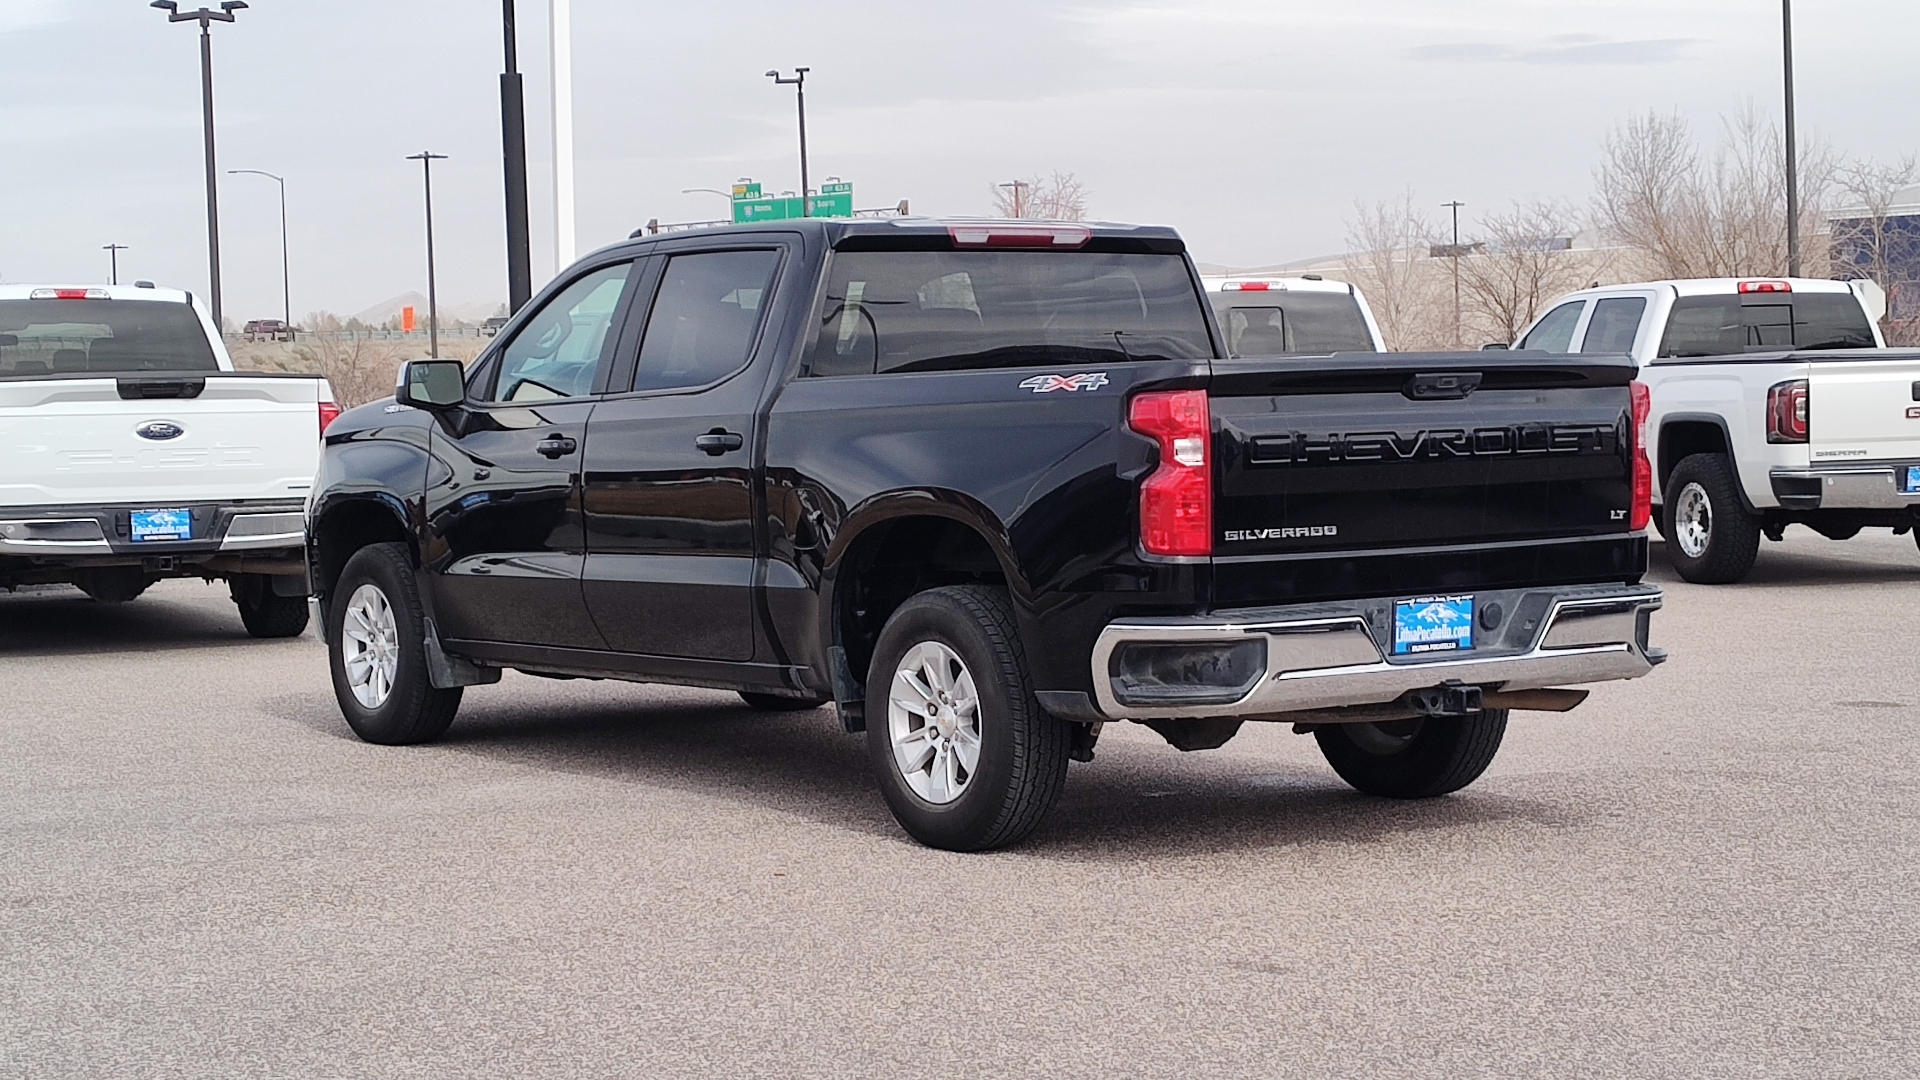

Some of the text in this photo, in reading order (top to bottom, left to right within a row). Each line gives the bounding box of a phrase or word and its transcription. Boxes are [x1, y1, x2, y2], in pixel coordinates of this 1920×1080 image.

[1249, 424, 1614, 464] CHEVROLET
[1610, 509, 1627, 521] LT
[1224, 525, 1338, 542] SILVERADO
[1396, 623, 1470, 642] LithiaPocatello.com
